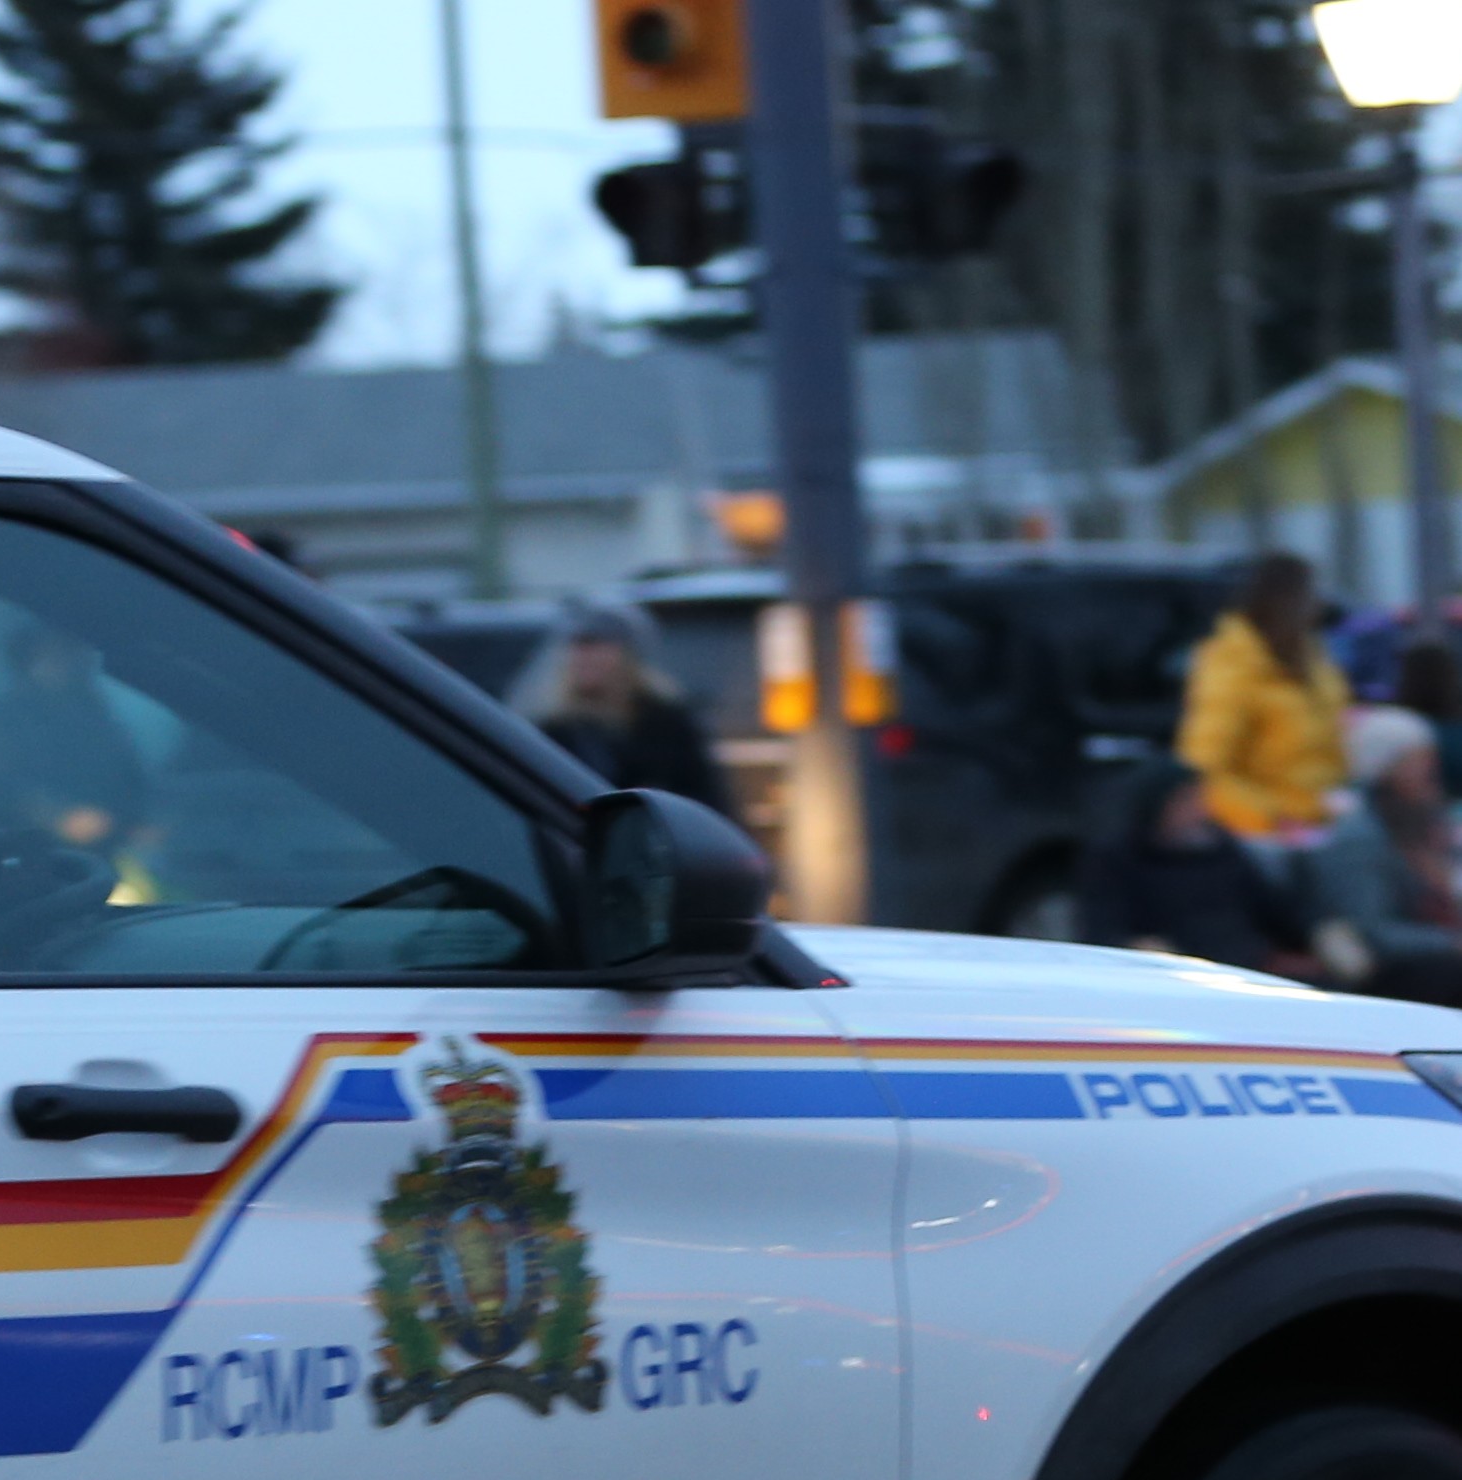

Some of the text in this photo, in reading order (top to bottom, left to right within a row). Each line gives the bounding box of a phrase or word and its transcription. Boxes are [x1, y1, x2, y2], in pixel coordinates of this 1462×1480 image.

[1081, 1072, 1340, 1119] POLICE
[161, 1317, 760, 1443] RCMP GRC
